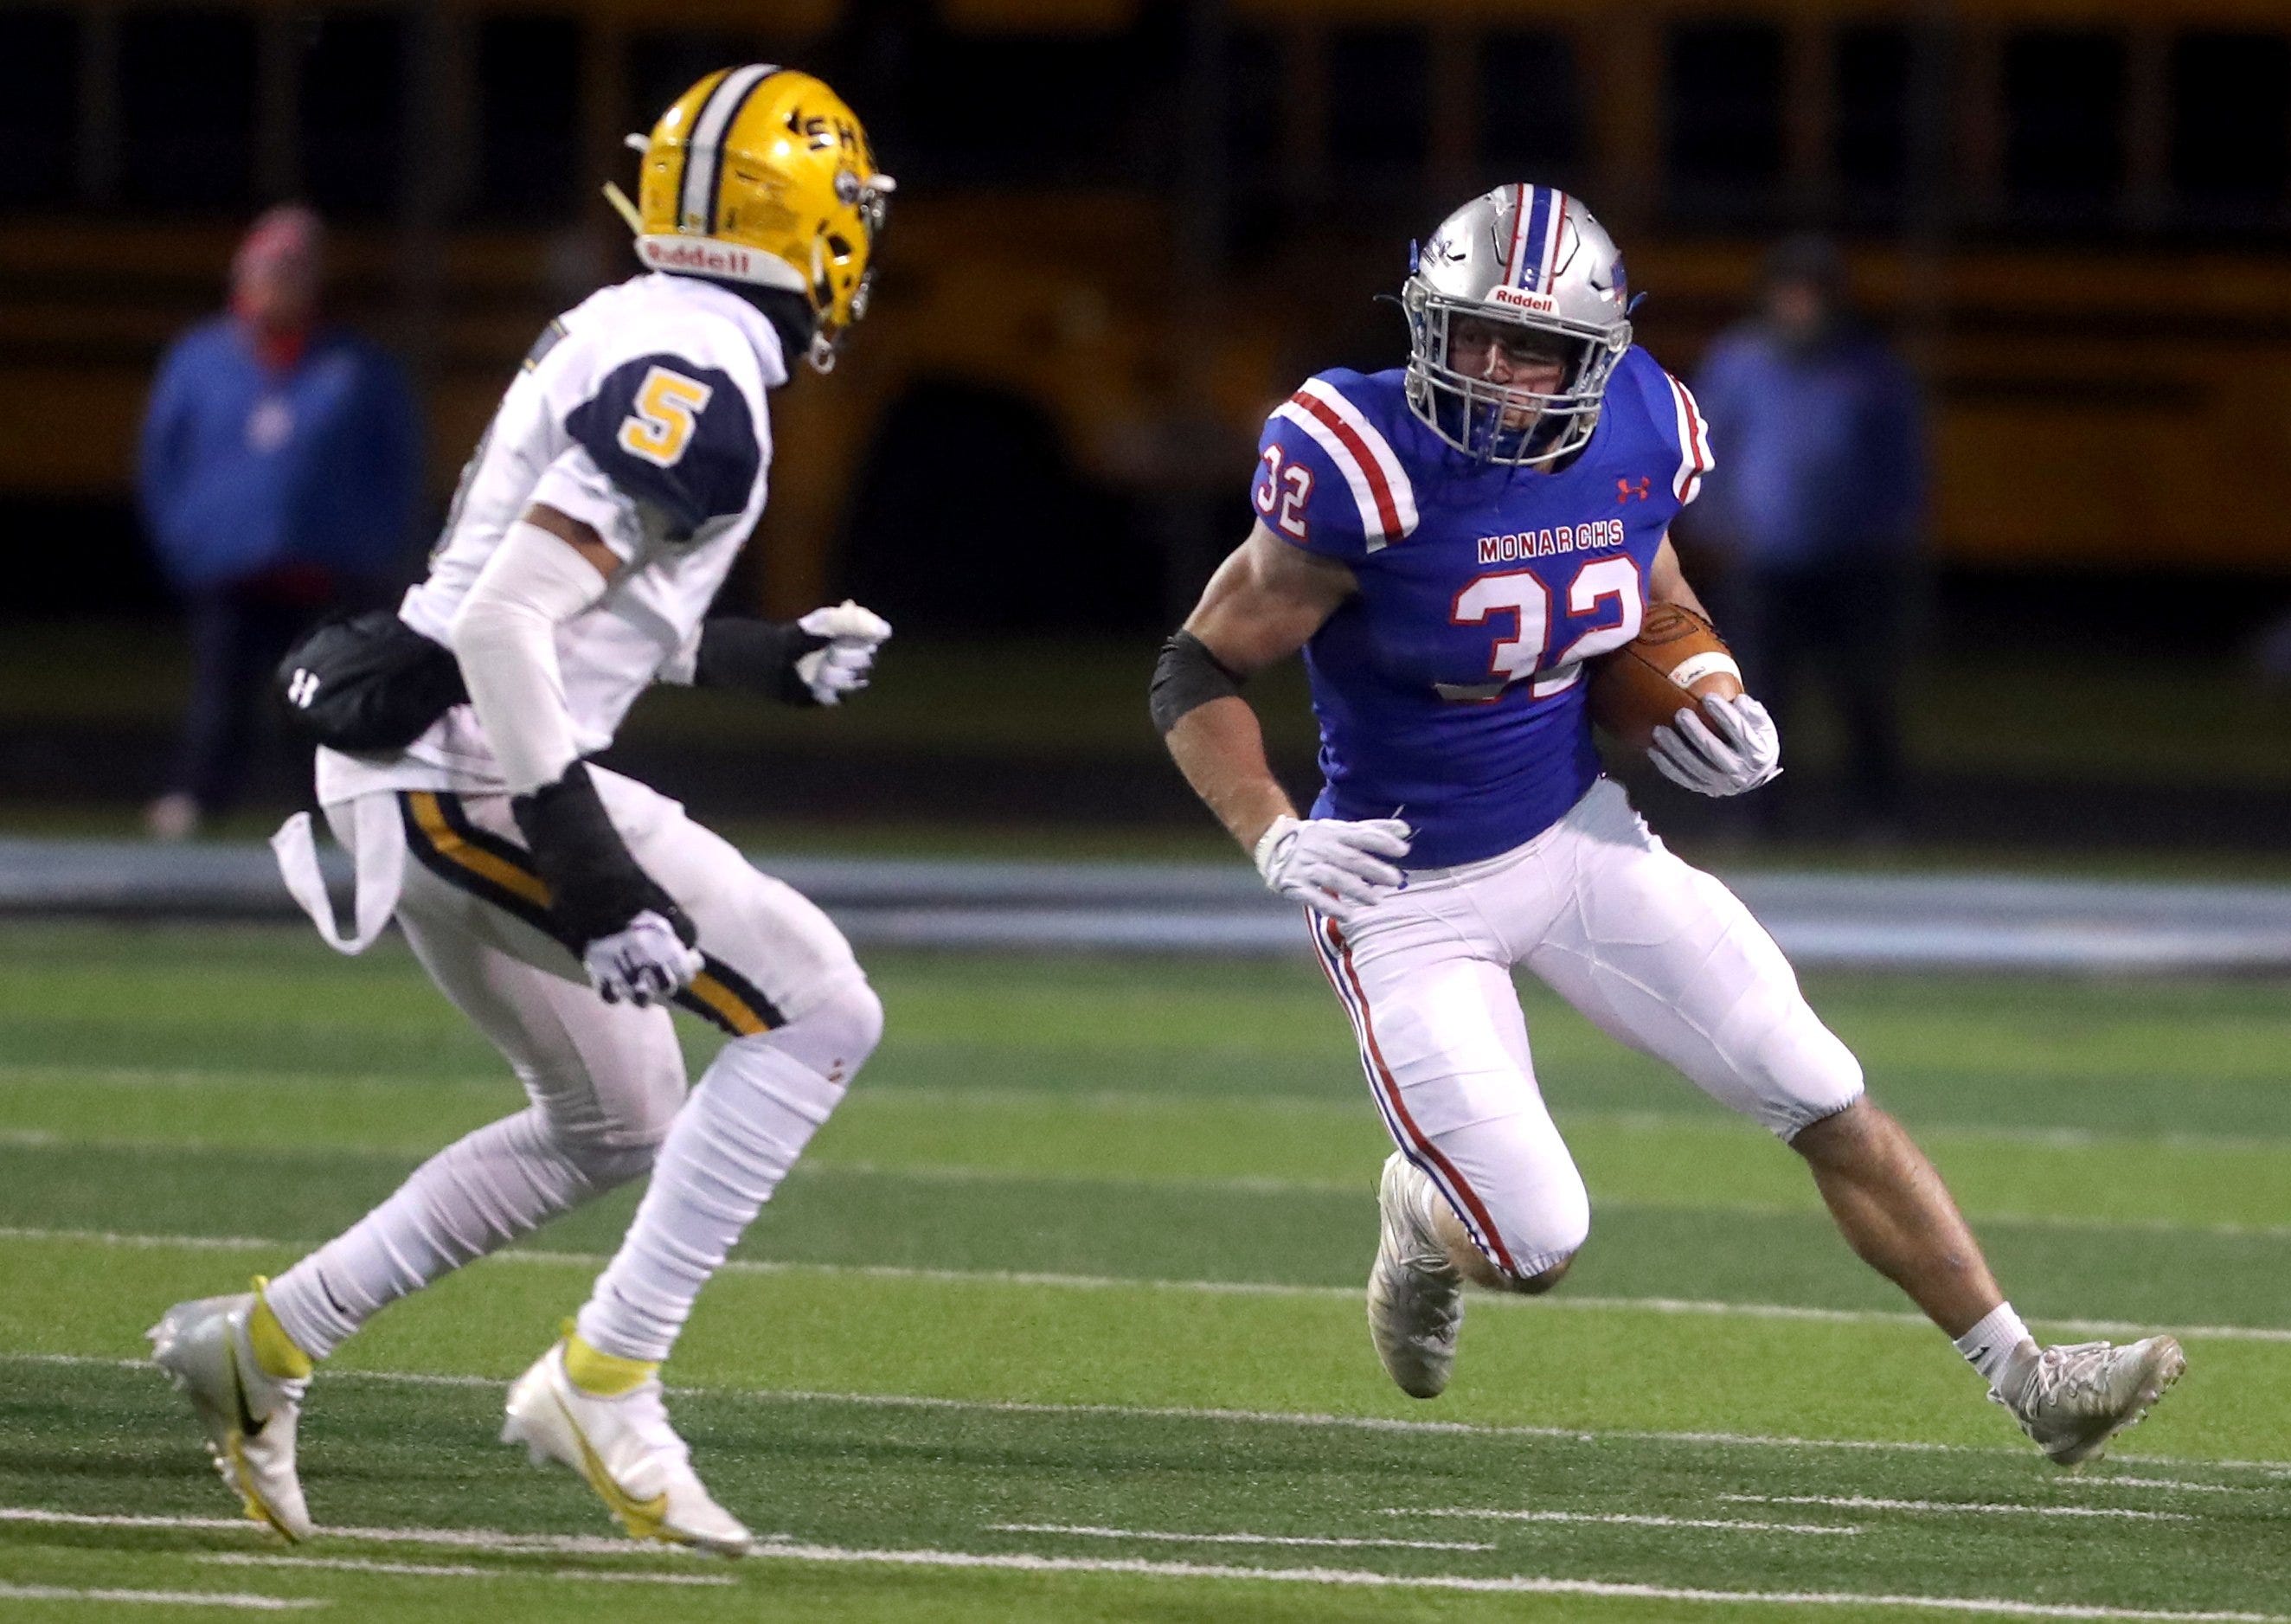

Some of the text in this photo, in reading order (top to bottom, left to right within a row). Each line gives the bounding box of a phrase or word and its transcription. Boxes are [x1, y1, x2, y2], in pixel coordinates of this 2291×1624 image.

[1496, 290, 1553, 311] Riddell
[617, 364, 714, 468] 5
[1257, 443, 1314, 542] 32
[1478, 519, 1624, 563] MONARCHS
[1438, 551, 1647, 705] 32
